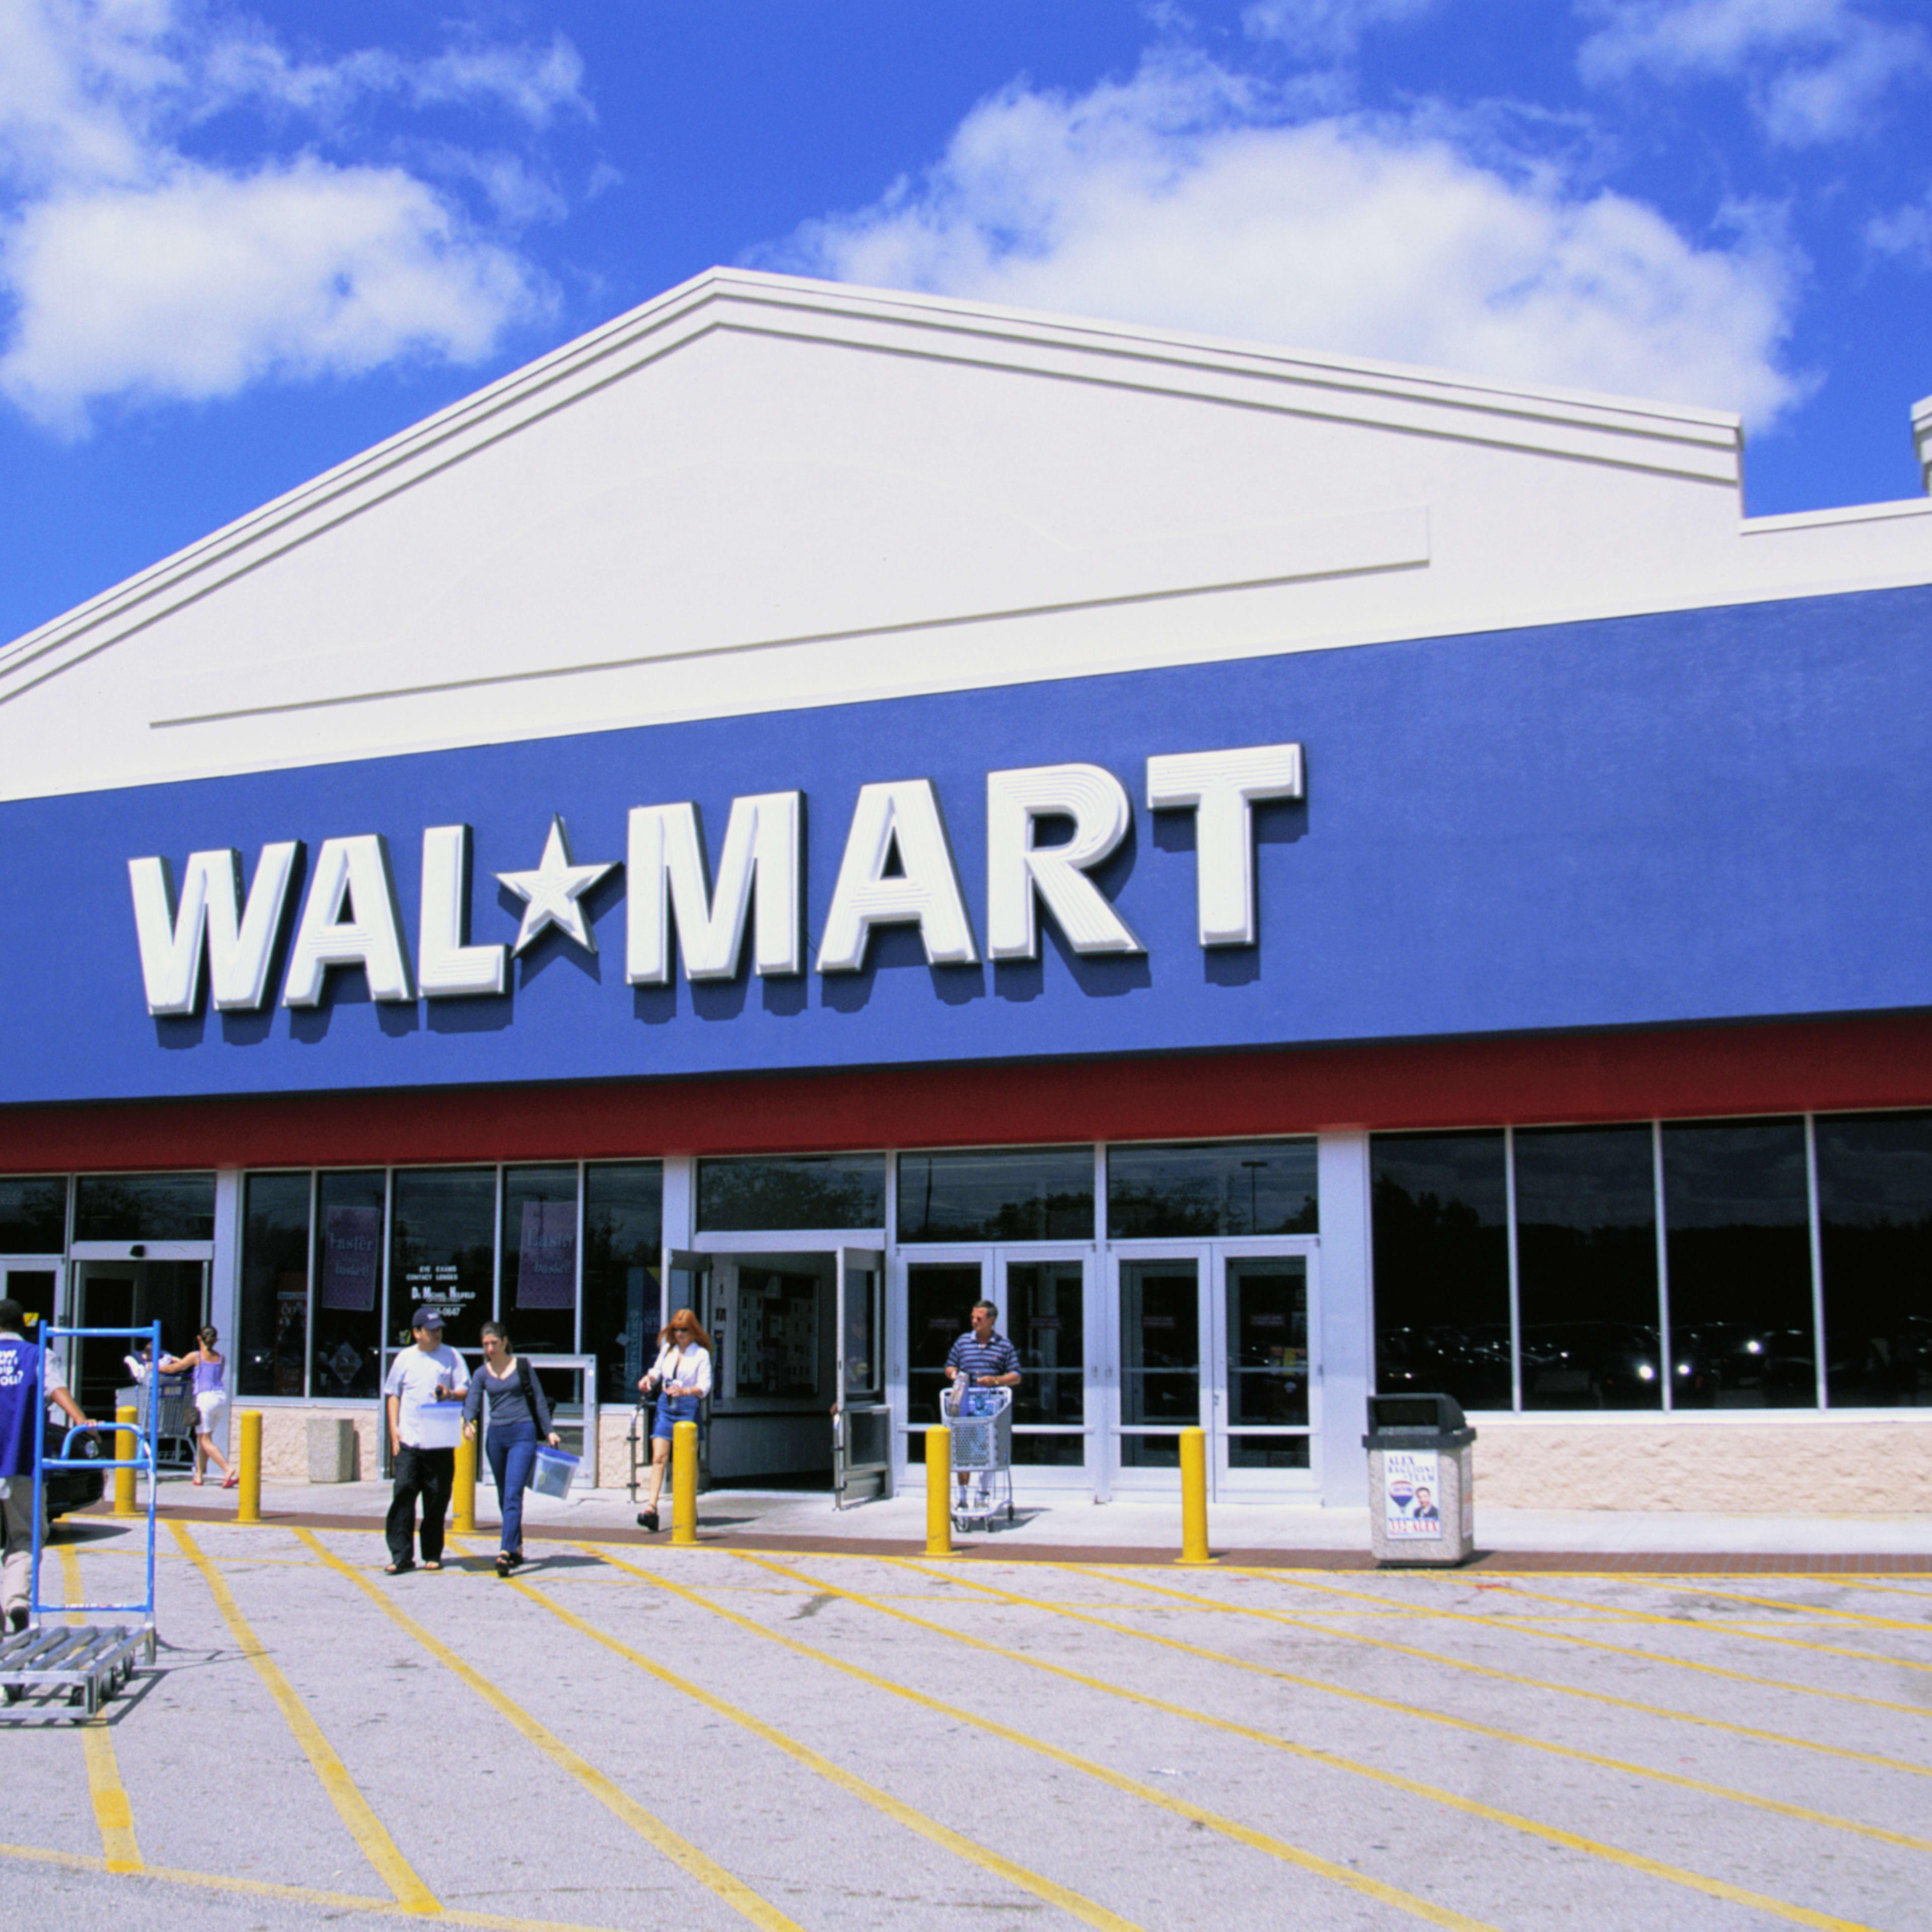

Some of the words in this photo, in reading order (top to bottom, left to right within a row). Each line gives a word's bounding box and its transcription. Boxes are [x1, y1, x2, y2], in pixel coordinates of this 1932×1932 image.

[127, 824, 508, 1016] WAL
[626, 742, 1305, 987] MART
[0, 1371, 24, 1386] ou?
[1389, 1457, 1414, 1465] ALEX
